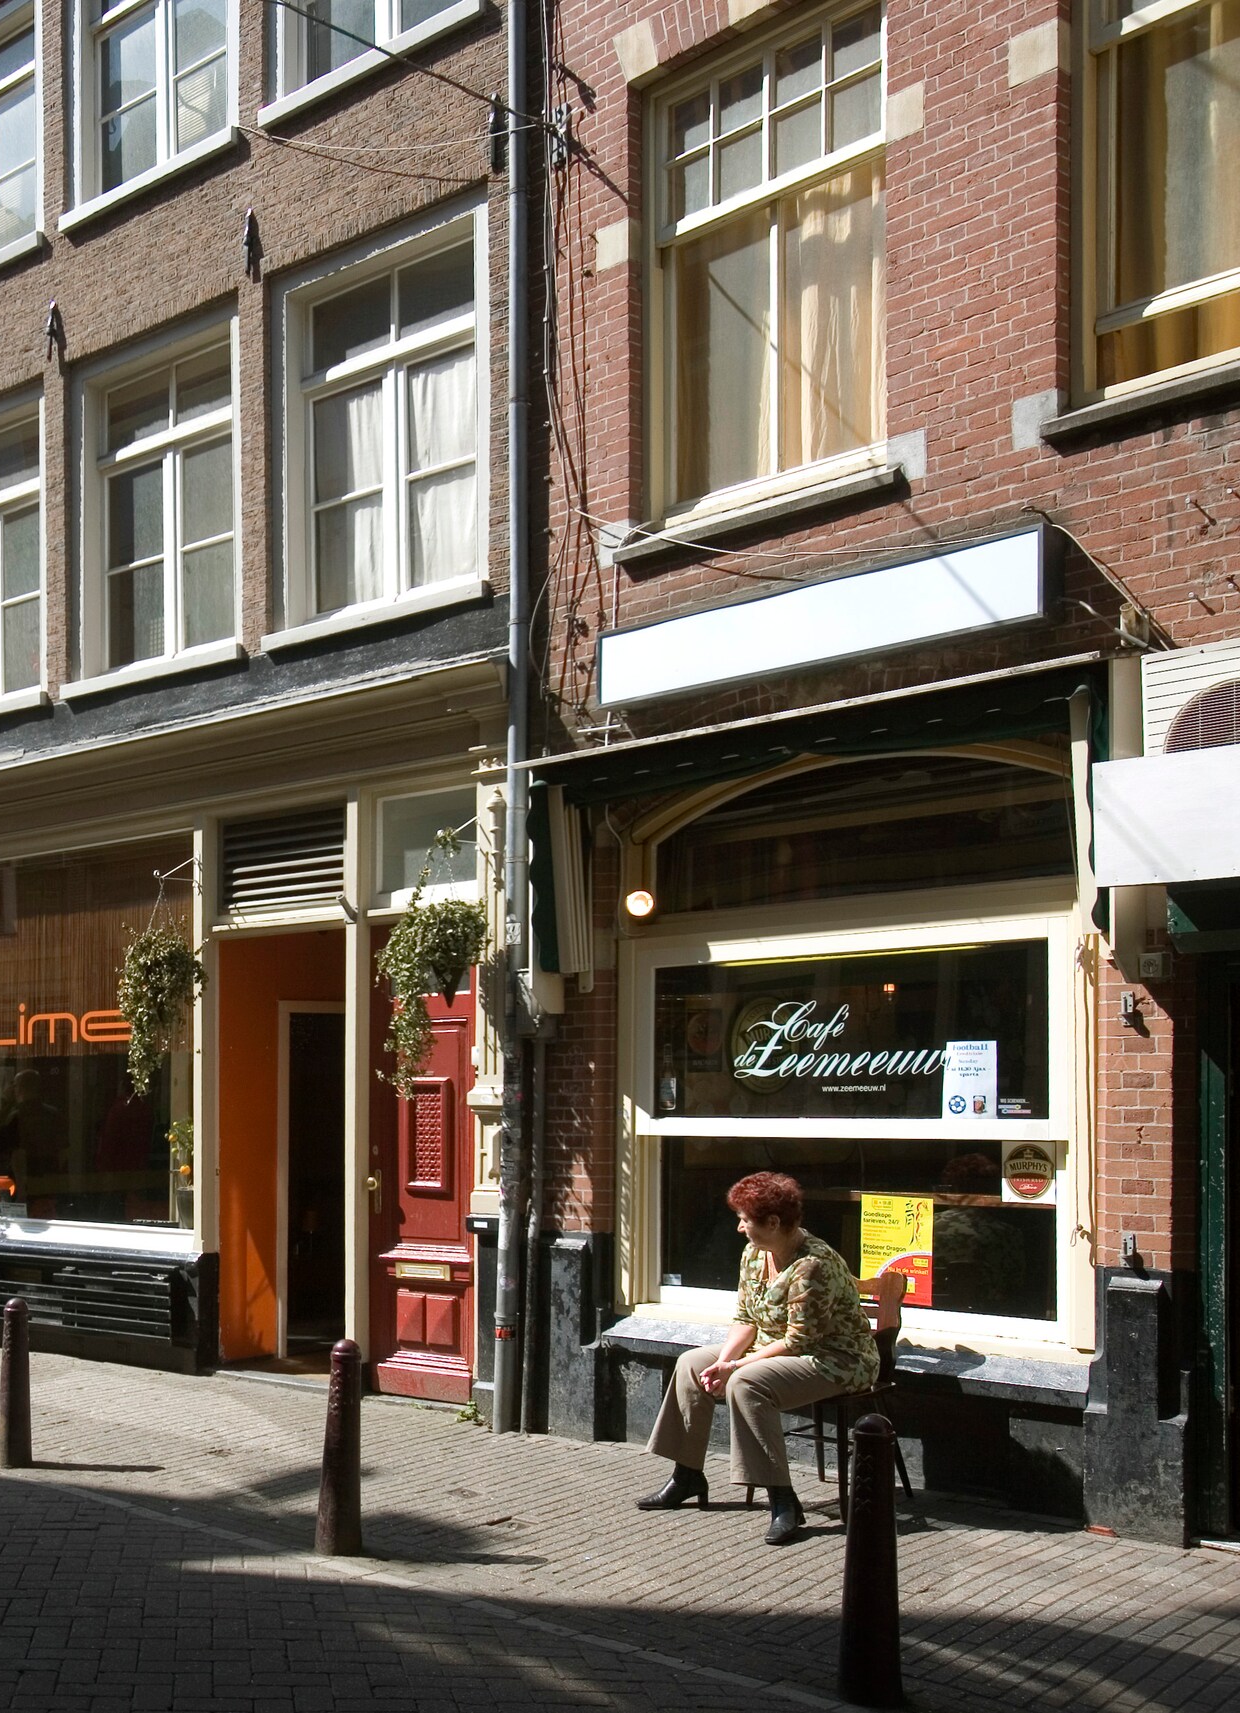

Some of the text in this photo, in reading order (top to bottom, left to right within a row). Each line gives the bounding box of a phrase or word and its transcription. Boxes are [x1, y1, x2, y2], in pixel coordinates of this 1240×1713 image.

[734, 1021, 951, 1078] de Zeemeeuw
[772, 1000, 849, 1050] Café
[822, 1084, 886, 1093] www.zeemeeuw.nl
